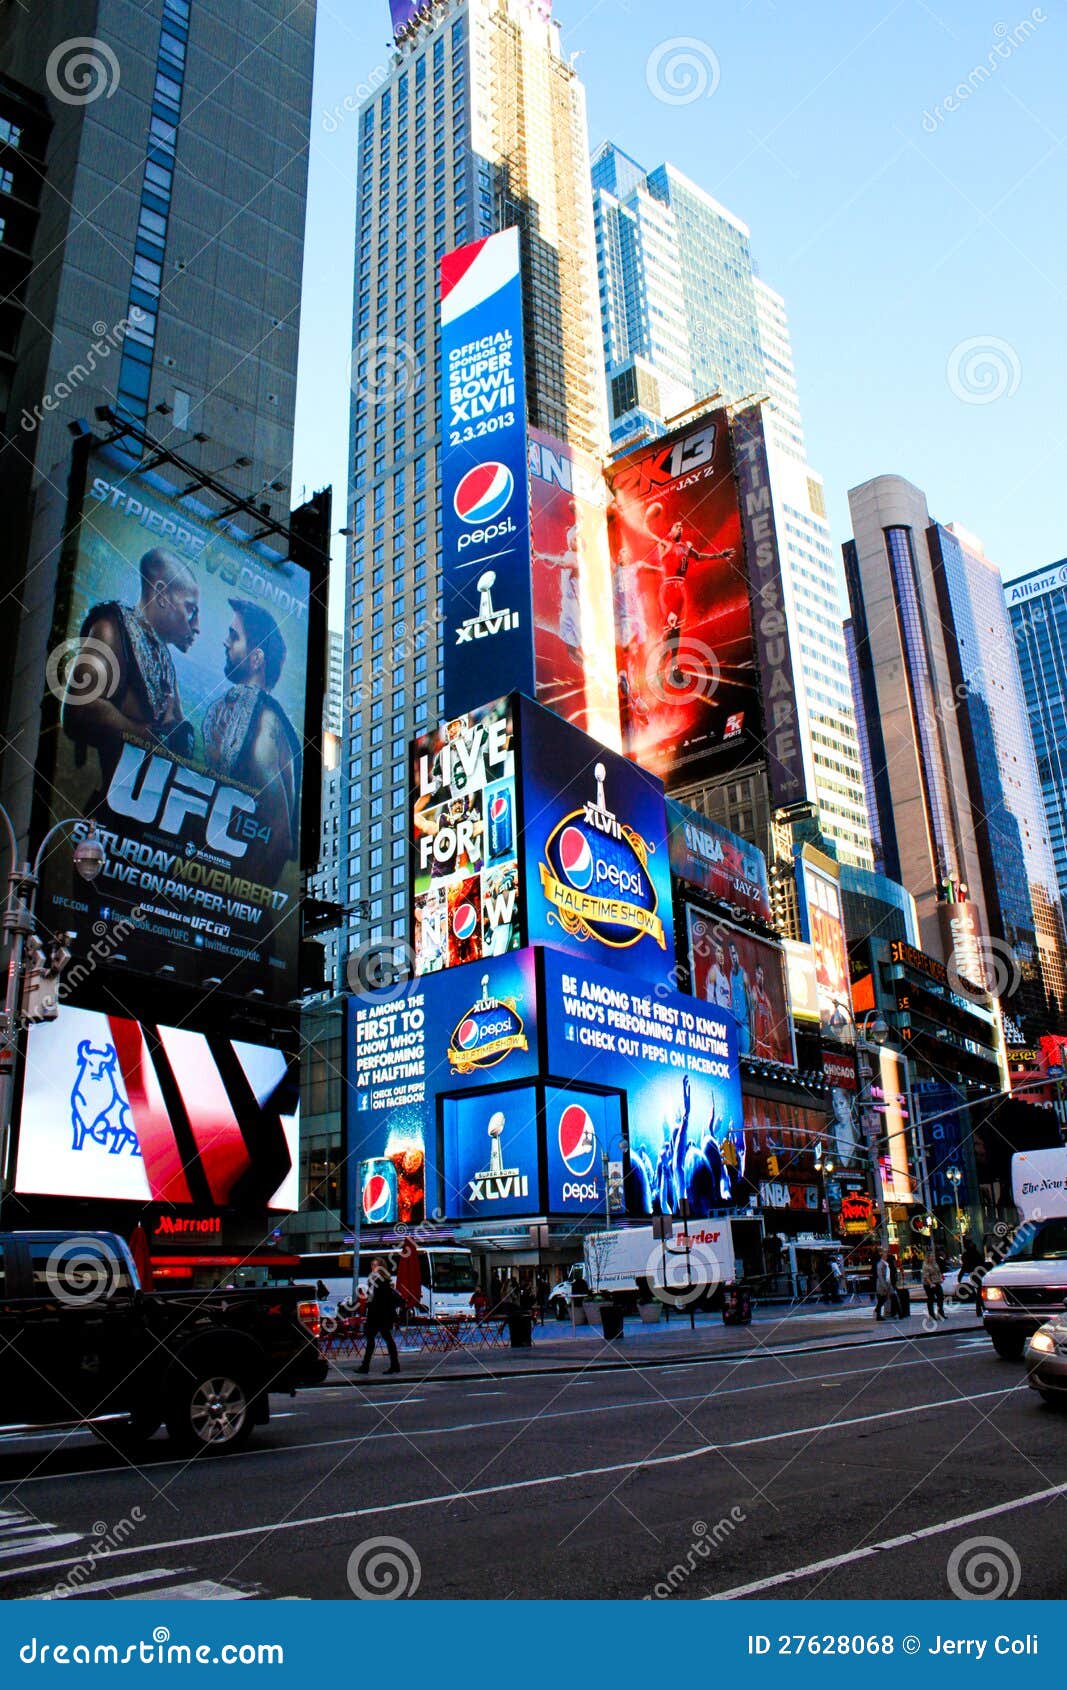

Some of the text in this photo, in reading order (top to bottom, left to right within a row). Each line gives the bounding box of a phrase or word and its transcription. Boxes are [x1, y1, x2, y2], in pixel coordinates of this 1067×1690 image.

[448, 328, 513, 362] OFFICIAL
[448, 340, 513, 372] SPONSOR OF
[448, 351, 513, 387] SUPER
[450, 368, 515, 405] BOWL
[450, 384, 515, 427] XLVII
[450, 412, 515, 447] 2.3.2013
[675, 471, 701, 492] JAY
[90, 478, 205, 558] ST-PIERRE
[239, 566, 308, 619] CONDIT
[737, 435, 797, 761] TIMES SQUARE
[1011, 574, 1057, 601] Allianz
[455, 611, 520, 646] XLVII
[419, 717, 507, 797] LIVE
[107, 742, 257, 858] UFC
[233, 813, 272, 845] 154
[583, 805, 622, 841] XLVII
[419, 819, 481, 870] FOR
[690, 825, 725, 864] NBA
[103, 859, 263, 923] LIVE ON PAY-PER-VIEW
[173, 859, 272, 908] NOVEMBER
[270, 890, 289, 910] 17
[733, 876, 752, 897] JAY
[51, 894, 90, 913] UFC.COM
[139, 902, 154, 913] ALSO
[554, 885, 655, 931] HALFTIME SHOW
[357, 994, 425, 1022] BE AMONG THE
[473, 999, 499, 1014] XLVII
[562, 974, 727, 1040] BE AMONG THE FIRST TO KNOW
[357, 1009, 425, 1043] FIRST TO
[563, 996, 729, 1058] WHO'S PERFORMING AT HALFTIME
[357, 1030, 425, 1058] KNOW WHO'S
[357, 1046, 425, 1072] PERFORMING
[455, 1037, 520, 1062] HALFTIME SHOW
[579, 1028, 730, 1080] CHECK OUT PEPSI ON FACEBOOK
[357, 1060, 425, 1088] AT HALFTIME
[823, 1062, 855, 1080] CHICAGO
[372, 1081, 425, 1102] CHECK OUT PEPSI
[372, 1091, 425, 1110] ON FACEBOOK
[468, 1175, 529, 1202] XLVII
[766, 1181, 791, 1209] NBA
[1022, 1178, 1063, 1195] The New
[154, 1215, 221, 1234] Marriott
[676, 1229, 721, 1249] Ryder
